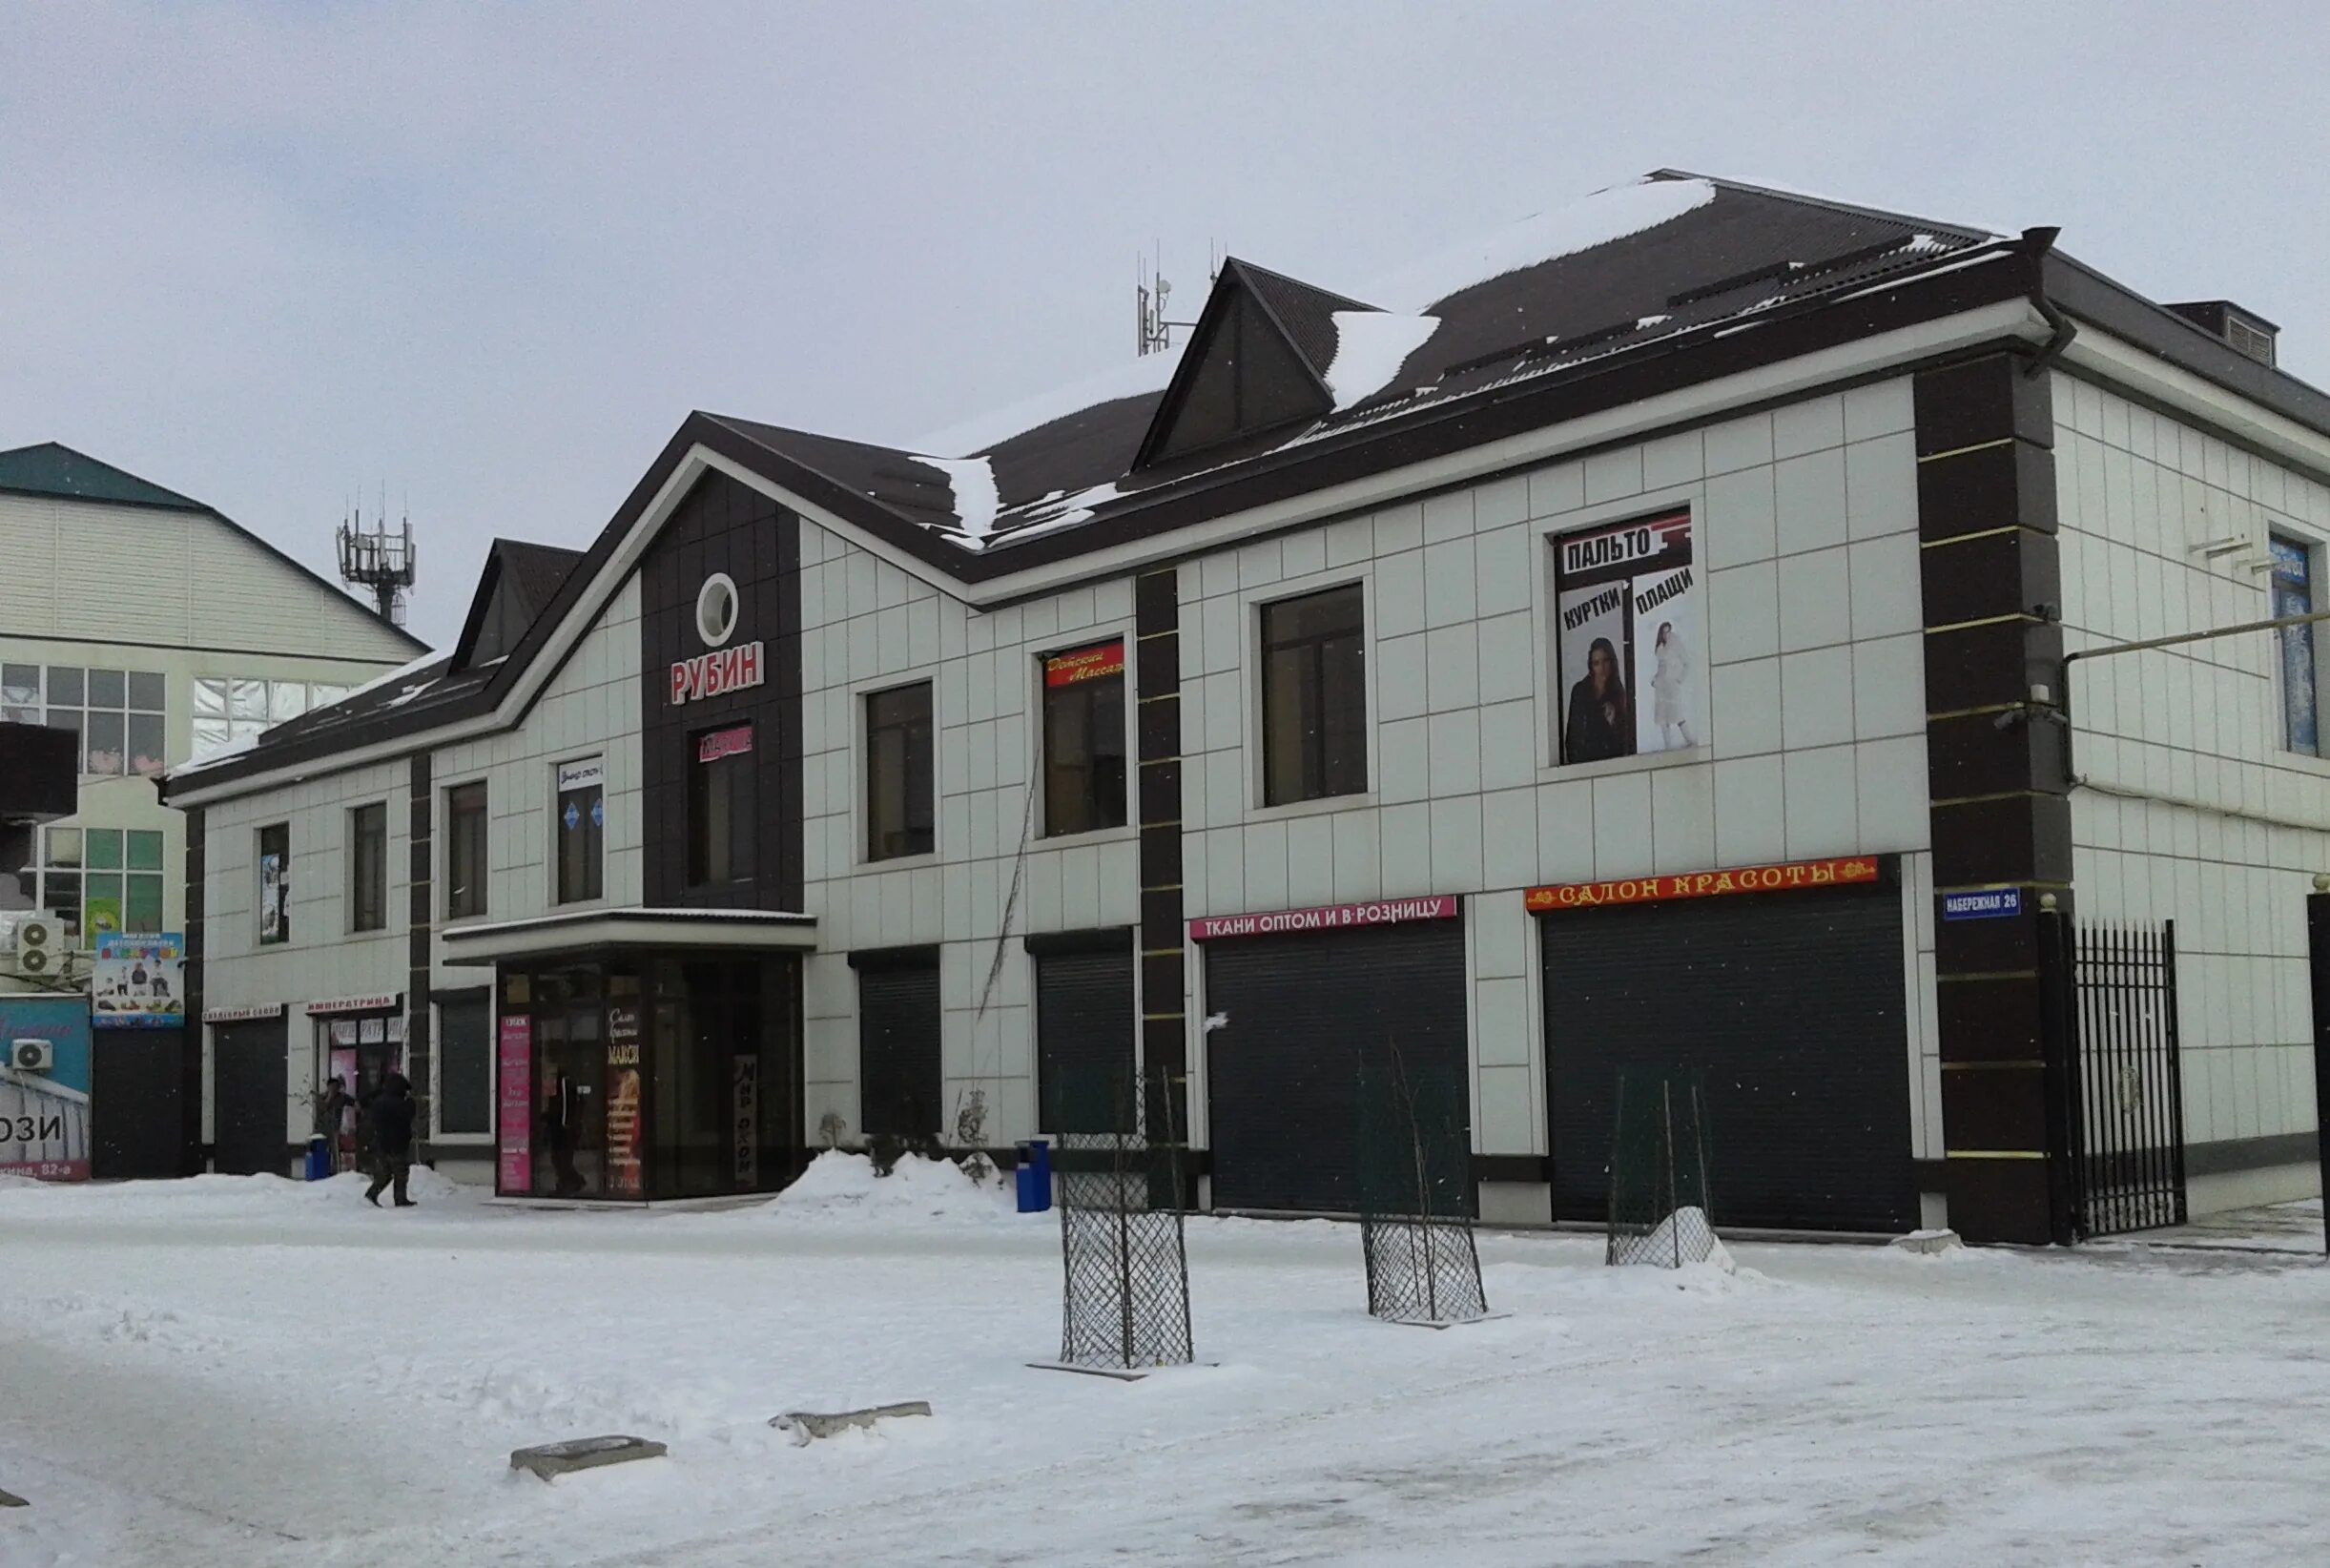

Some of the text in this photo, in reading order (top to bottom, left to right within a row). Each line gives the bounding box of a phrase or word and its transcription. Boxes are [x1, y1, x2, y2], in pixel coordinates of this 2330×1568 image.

[1568, 527, 1650, 570] ПАЛЬТО
[1563, 587, 1621, 630] КУРТКИ
[1635, 567, 1694, 615] ПЛАЩИ
[670, 641, 764, 705] РУБИН
[1558, 862, 1837, 906] САЛОН КРАСОТЫ
[1947, 894, 2017, 913] НАБЕРЕЖНАЯ 26
[1205, 899, 1442, 937] ТКАНИ ОПТОМ И В РОЗНИЦУ
